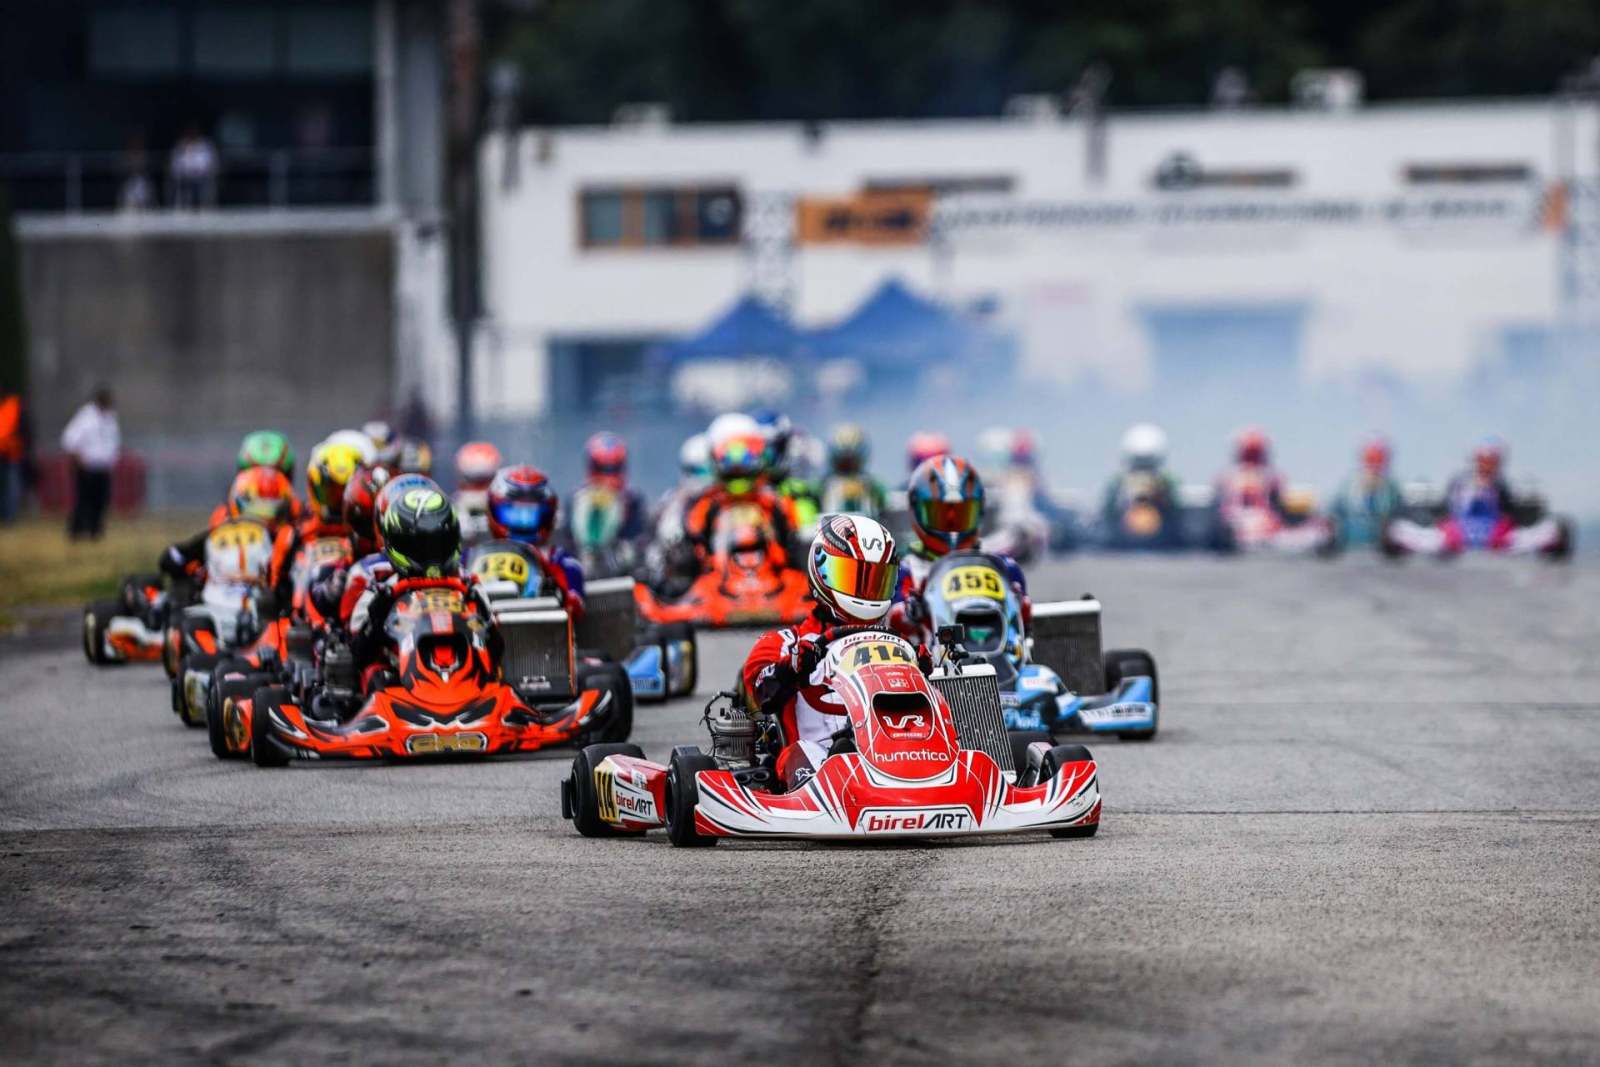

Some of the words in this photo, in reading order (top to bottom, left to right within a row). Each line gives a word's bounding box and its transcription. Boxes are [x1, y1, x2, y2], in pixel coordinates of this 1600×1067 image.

[948, 572, 1000, 592] 455
[842, 633, 906, 649] birelART
[853, 645, 912, 666] 414
[882, 714, 925, 729] VR
[874, 748, 950, 763] humatica
[616, 790, 653, 817] birelART
[868, 813, 968, 832] birelART
